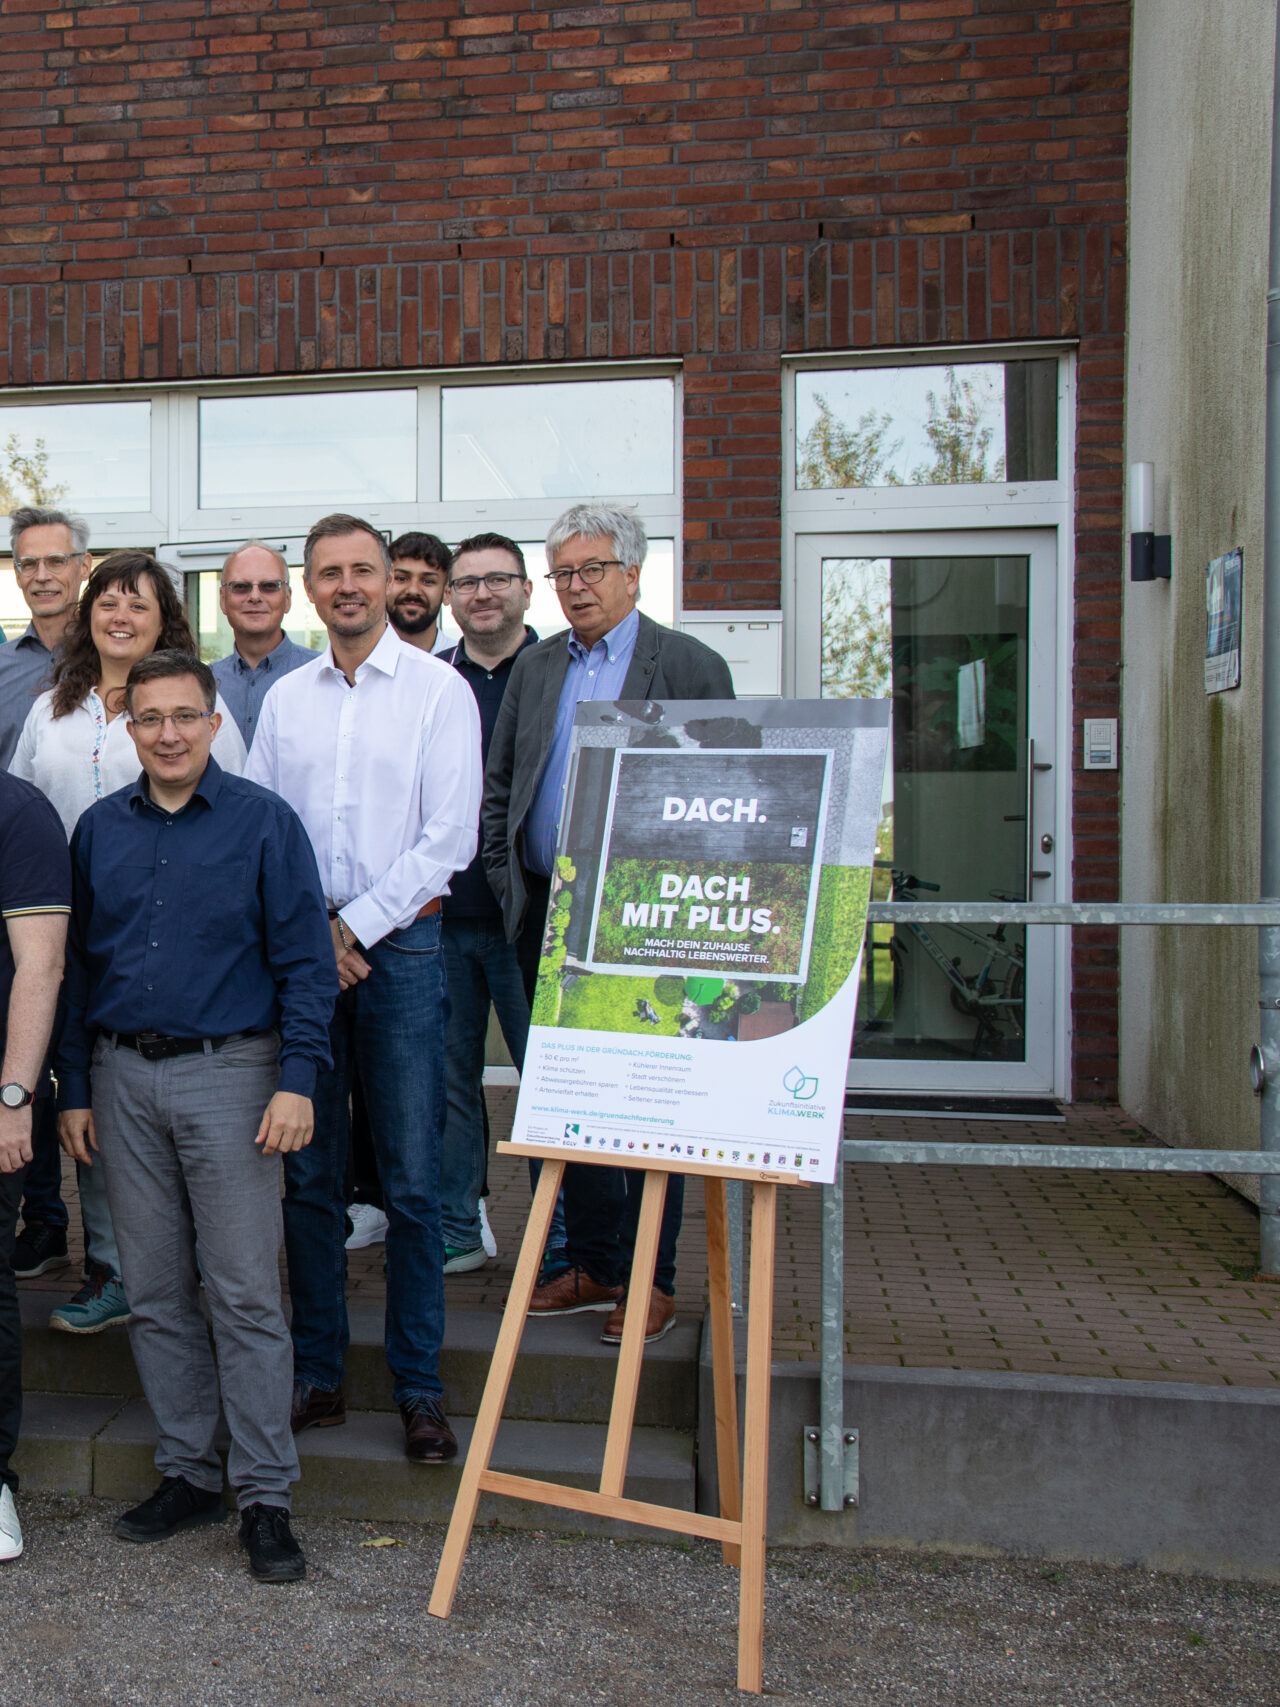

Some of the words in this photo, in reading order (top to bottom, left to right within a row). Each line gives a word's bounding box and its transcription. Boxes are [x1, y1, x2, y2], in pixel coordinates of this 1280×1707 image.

[662, 797, 767, 823] DACH.
[660, 874, 751, 901] DACH
[622, 902, 679, 928] MIT
[687, 906, 781, 934] PLUS.
[645, 938, 675, 948] MACH
[676, 940, 701, 950] DEIN
[703, 941, 751, 952] ZUHAUSE
[623, 947, 686, 959] NACHHALTIG
[687, 950, 770, 964] LEBENSWERTER.
[541, 1042, 556, 1050] DAS
[557, 1043, 575, 1051] PLUS
[577, 1044, 585, 1052] IN
[586, 1045, 601, 1053] DER
[768, 1099, 826, 1111] Zukunftsinitiative
[768, 1108, 825, 1119] KLIMA.WERK
